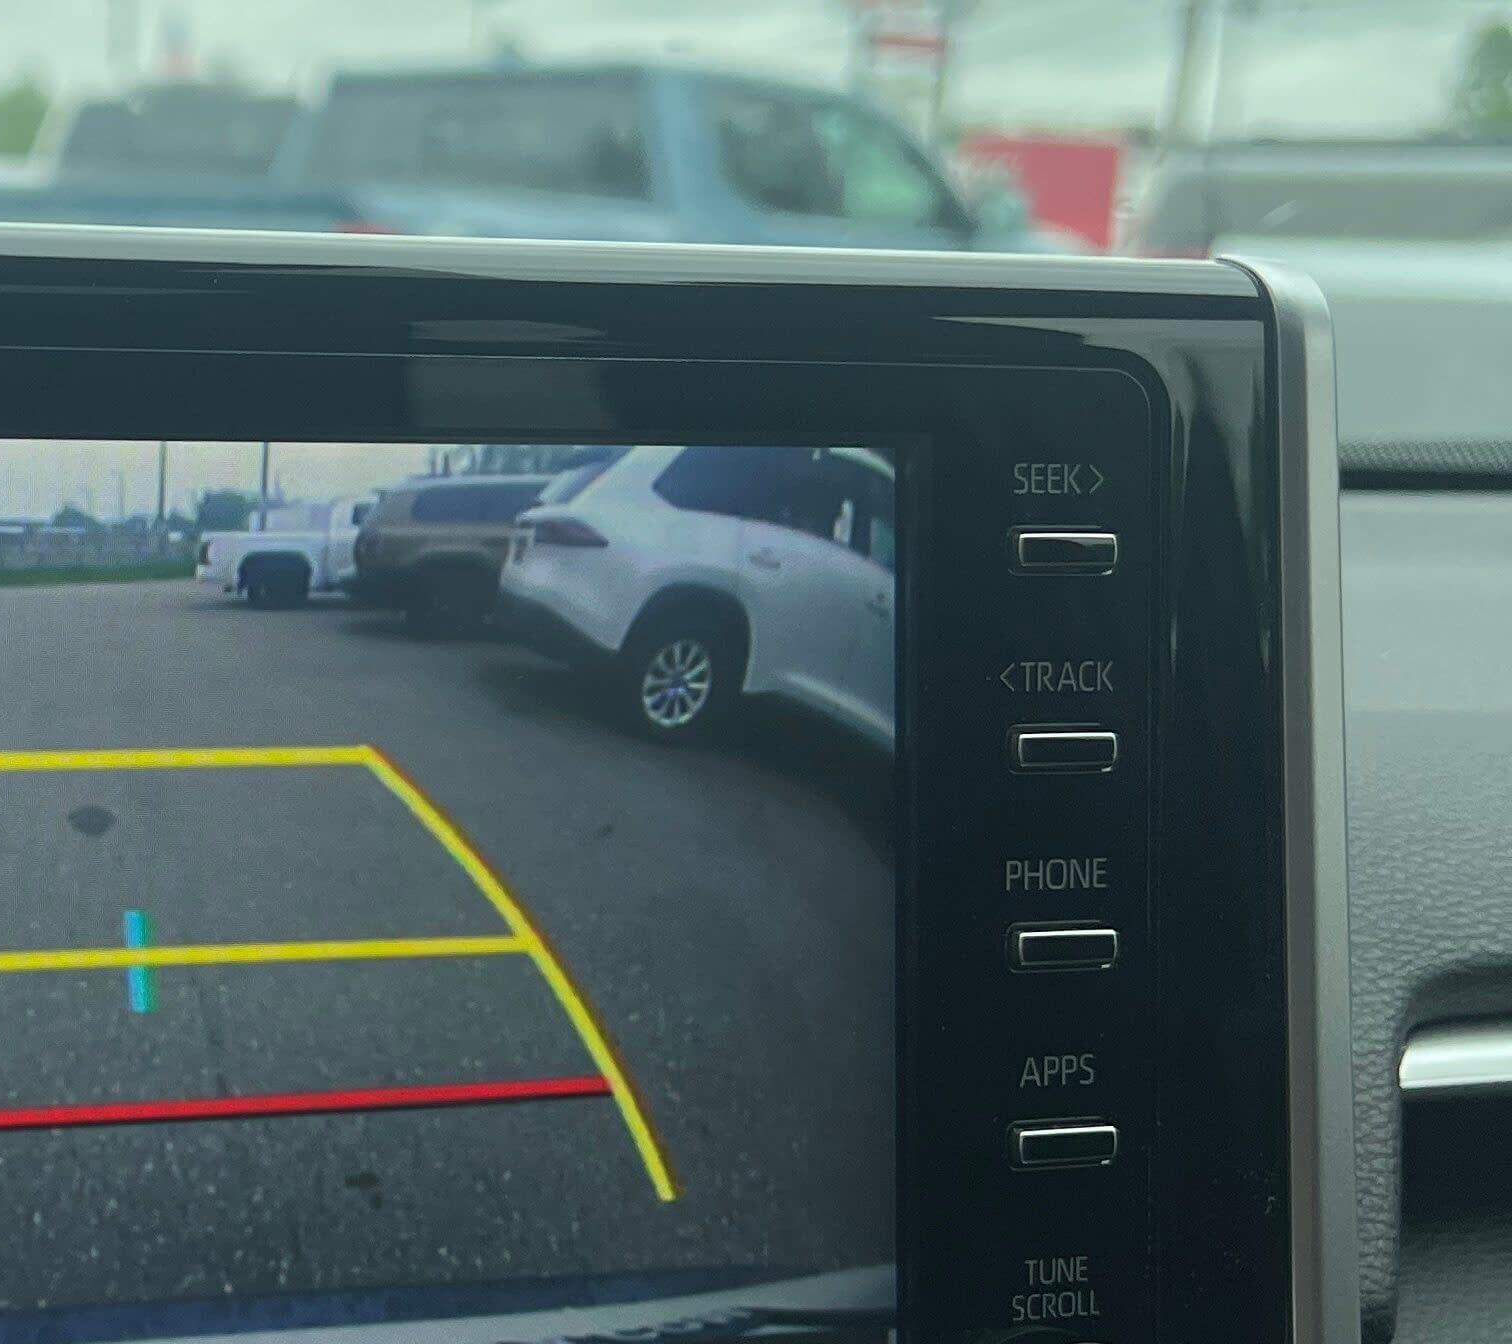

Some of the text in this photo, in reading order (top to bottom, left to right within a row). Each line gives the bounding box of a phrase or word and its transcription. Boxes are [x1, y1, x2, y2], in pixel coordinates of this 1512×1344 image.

[1013, 463, 1082, 495] SEEK
[1020, 660, 1114, 692] TRACK
[1005, 858, 1108, 892] PHONE
[1019, 1053, 1096, 1089] APPS
[1025, 1256, 1089, 1287] TUNE
[1011, 1289, 1100, 1322] SCROLL
